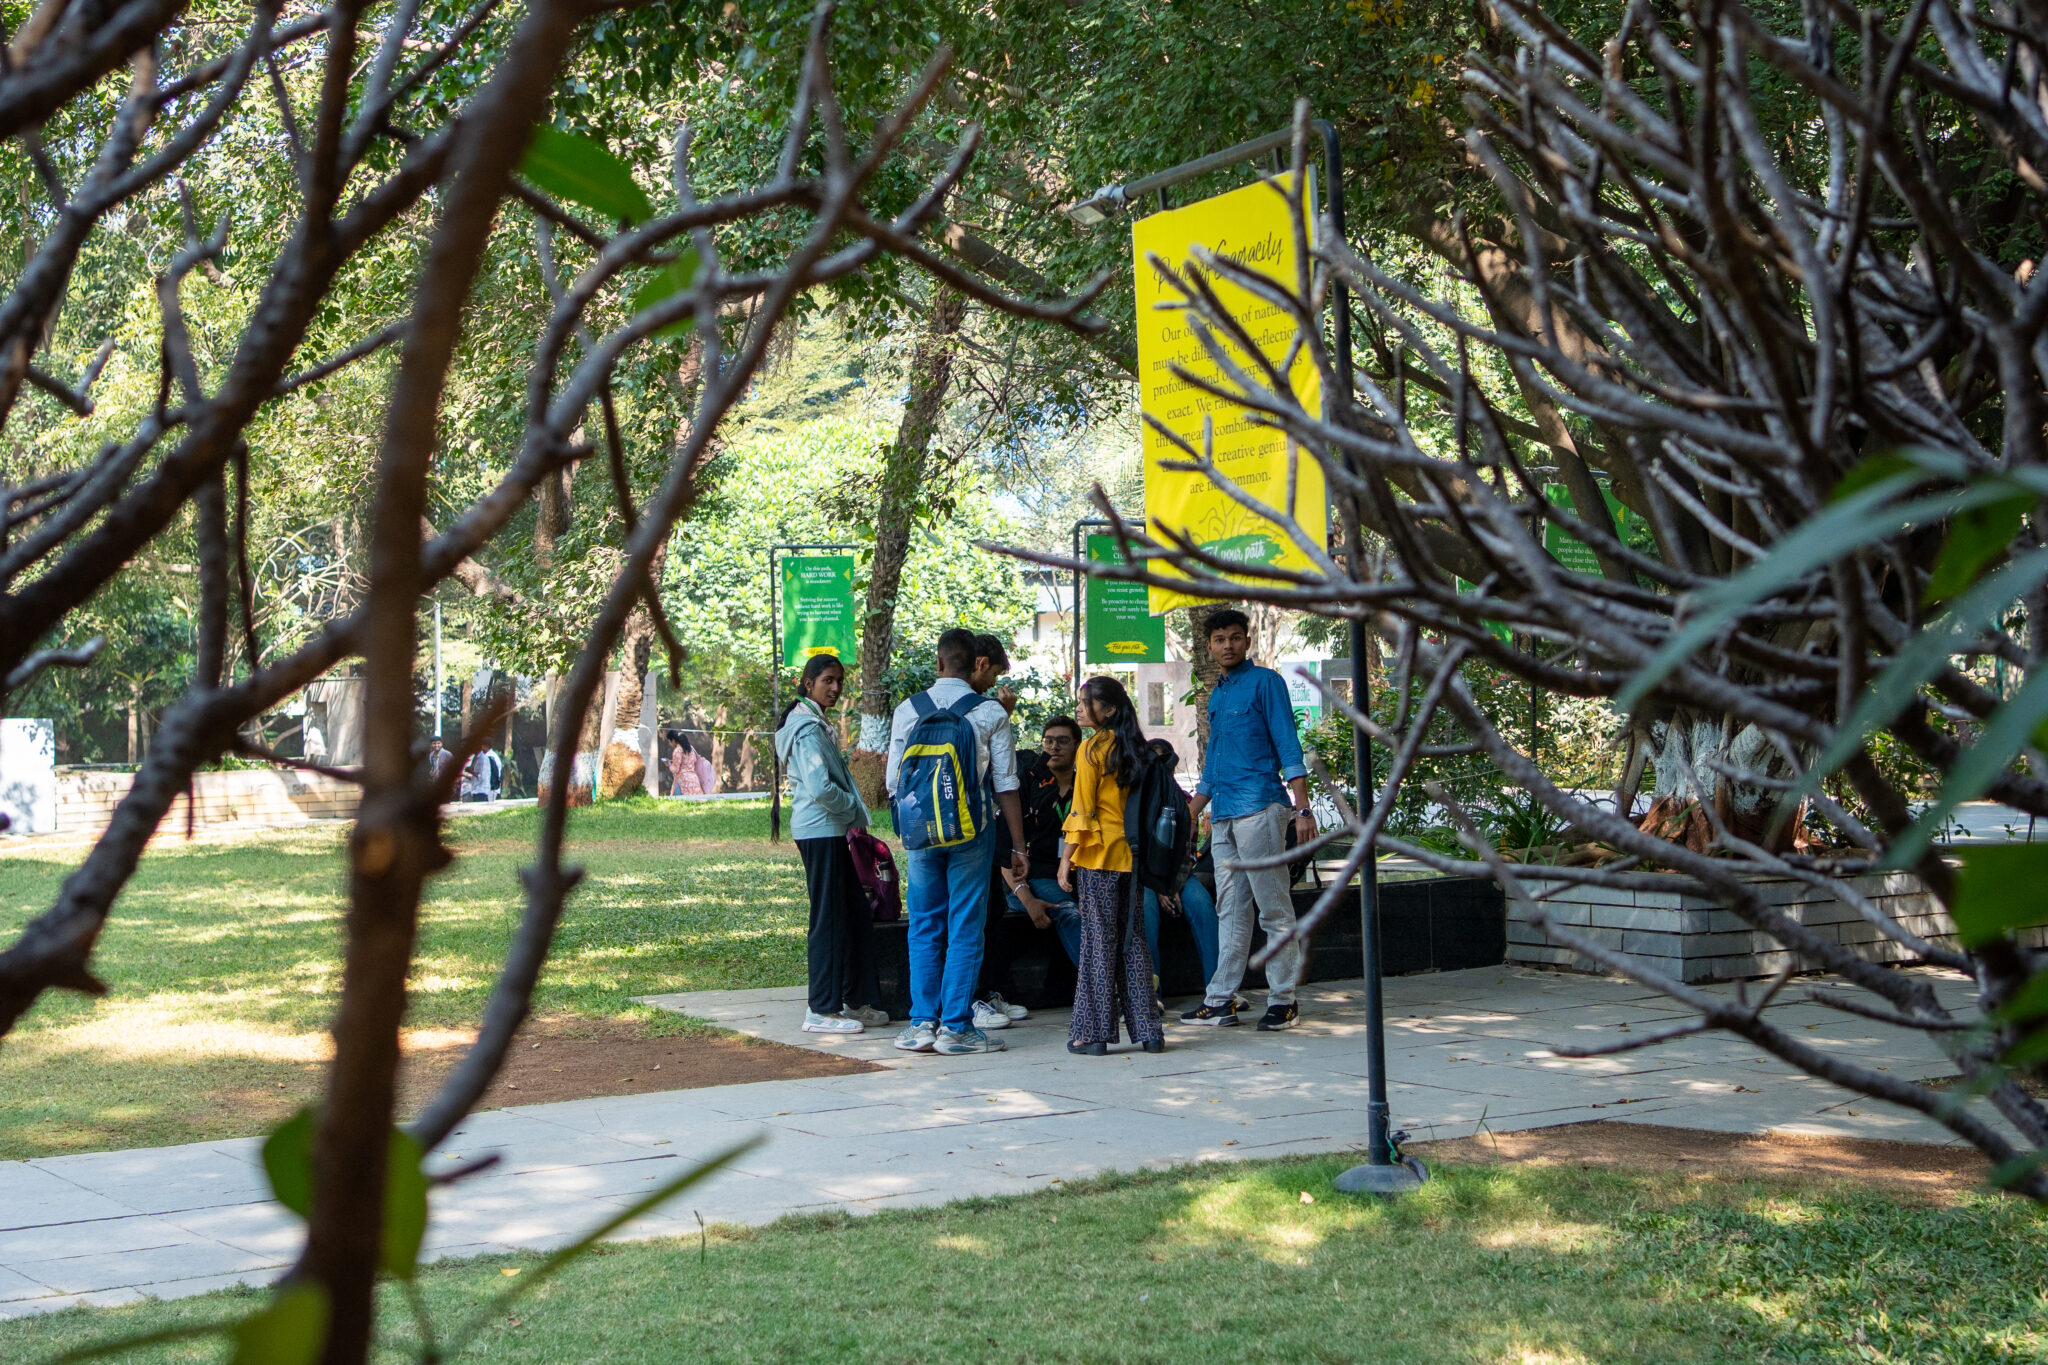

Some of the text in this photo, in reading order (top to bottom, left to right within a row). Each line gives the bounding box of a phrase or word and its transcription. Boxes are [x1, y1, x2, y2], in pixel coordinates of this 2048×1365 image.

[1162, 326, 1181, 343] Our
[1241, 305, 1253, 324] of
[1177, 350, 1189, 365] be
[1191, 343, 1230, 362] diligt,
[1166, 405, 1193, 420] exact.
[1196, 398, 1212, 413] We
[1217, 444, 1255, 463] creative
[1190, 482, 1205, 494] are
[1227, 471, 1272, 487] ommon.
